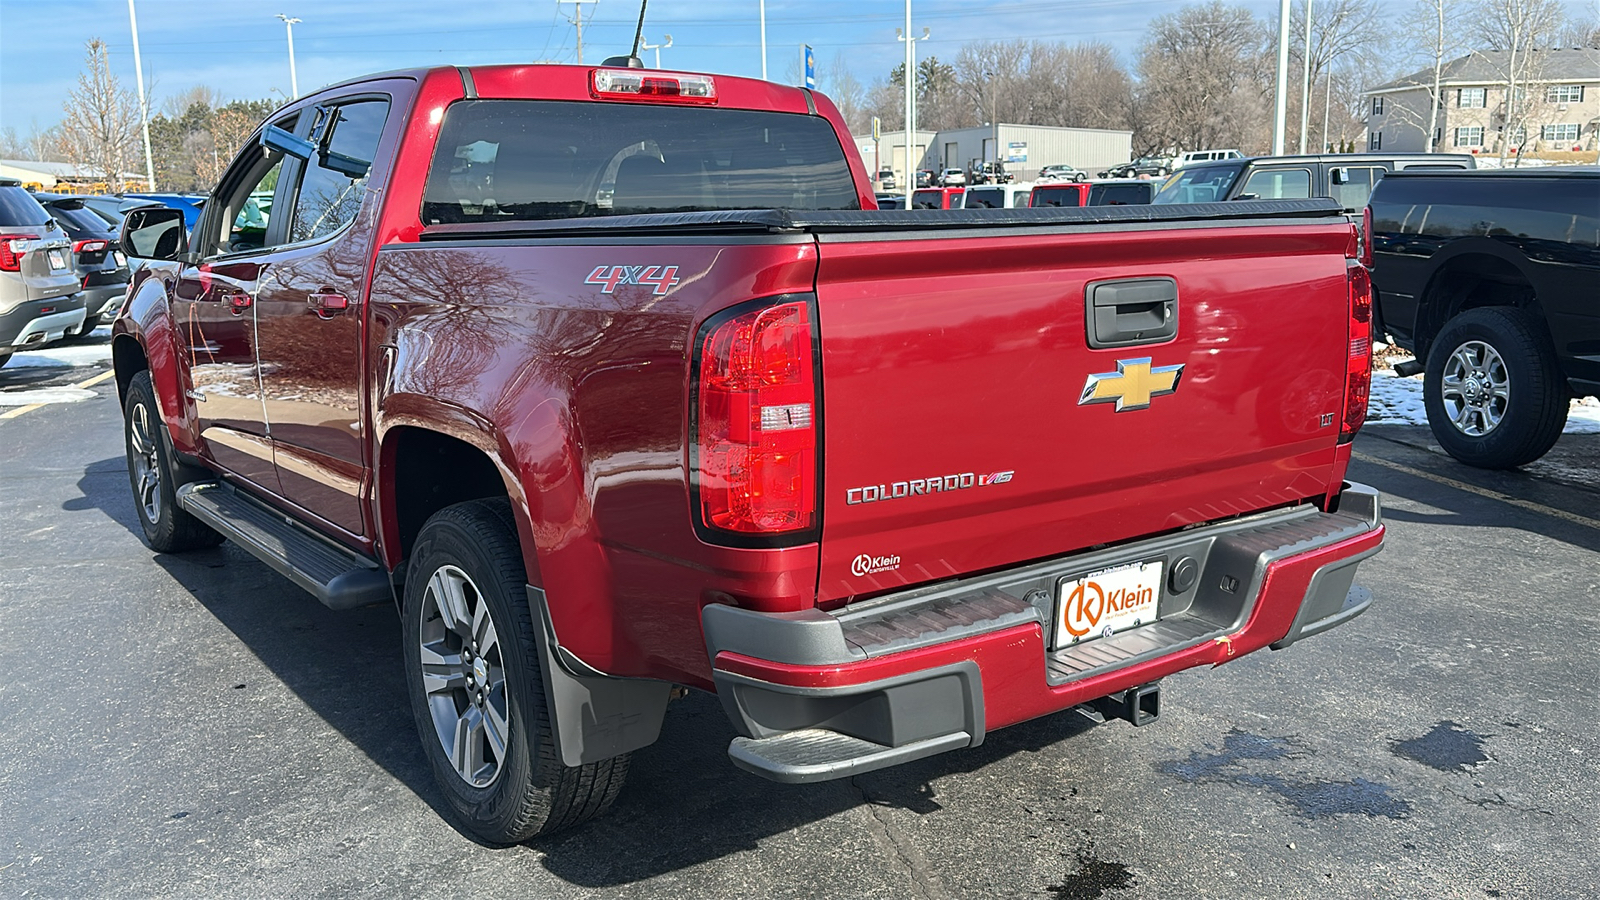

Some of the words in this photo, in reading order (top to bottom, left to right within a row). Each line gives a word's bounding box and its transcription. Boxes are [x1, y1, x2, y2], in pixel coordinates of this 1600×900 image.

[846, 472, 975, 505] COLORADO
[978, 470, 1015, 486] V6
[872, 554, 901, 568] Klein
[1106, 584, 1153, 614] Klein
